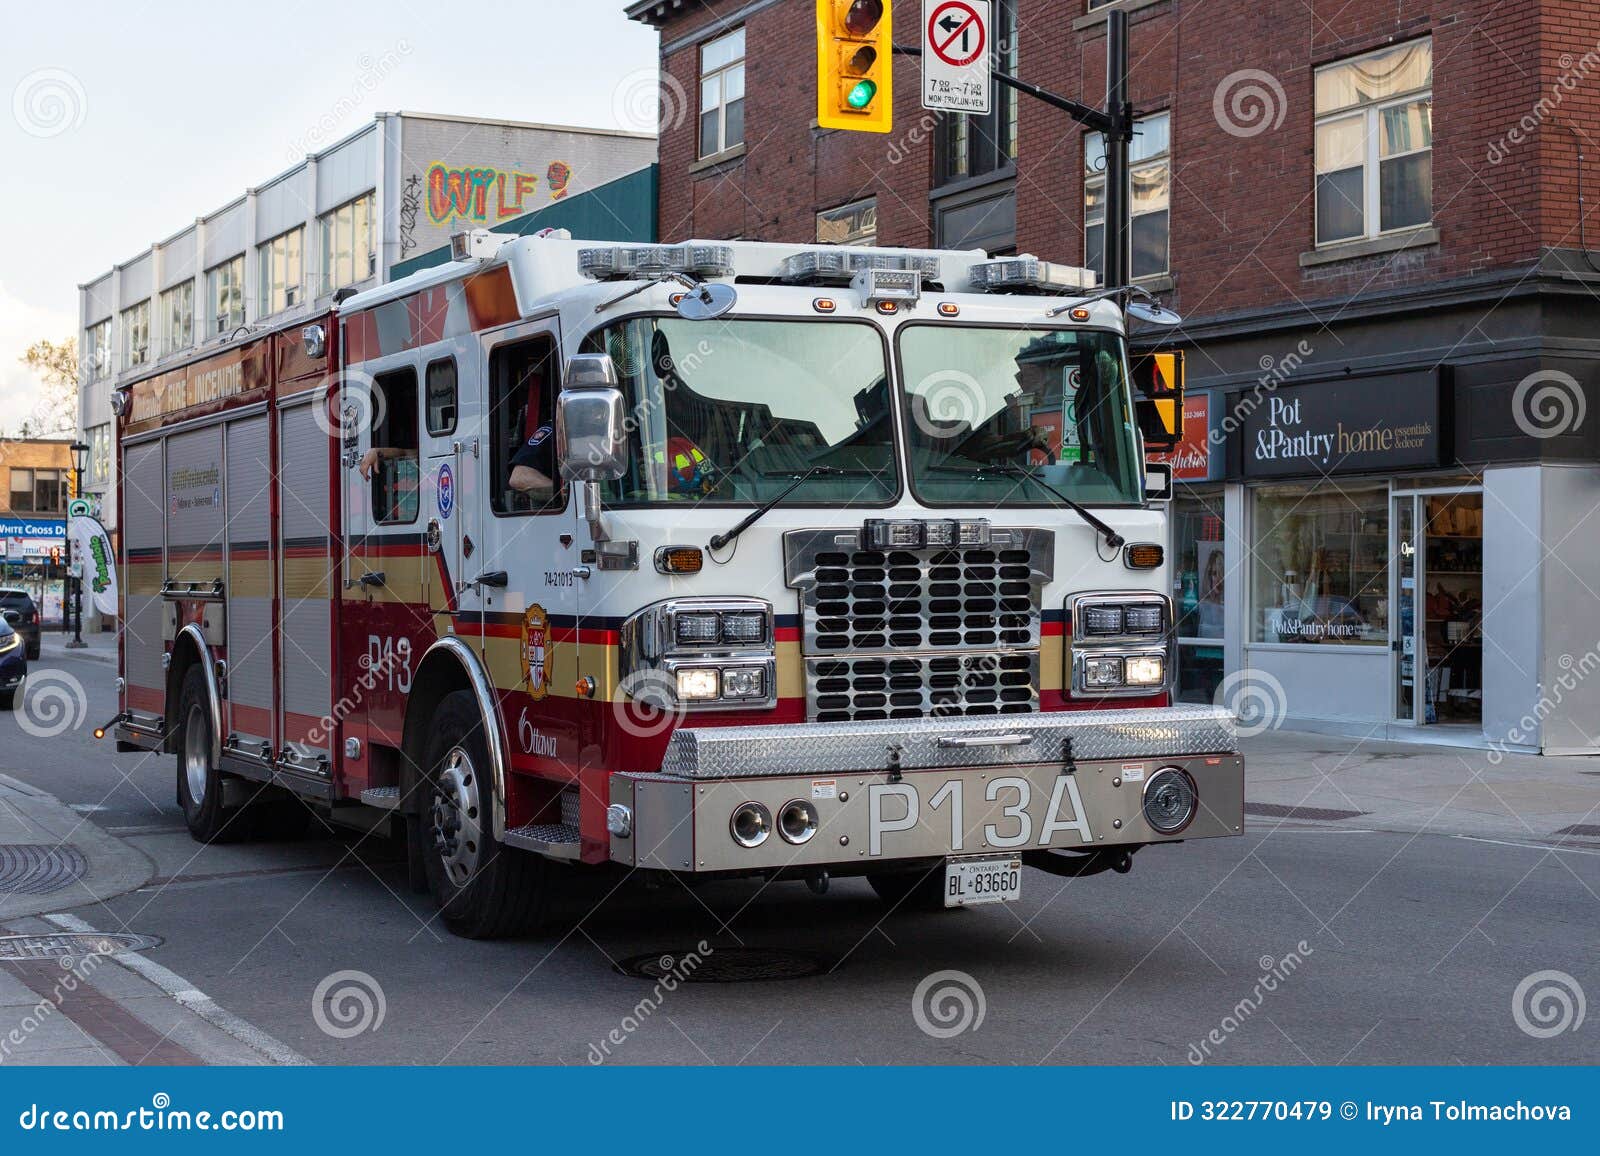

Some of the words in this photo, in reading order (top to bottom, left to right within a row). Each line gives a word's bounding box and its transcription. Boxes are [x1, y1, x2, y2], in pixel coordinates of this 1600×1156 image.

[931, 80, 937, 91] 7
[168, 380, 186, 412] FIRE
[195, 362, 241, 403] INCENDIE
[1269, 397, 1301, 426] Pot
[1255, 429, 1335, 464] &Pantry
[1338, 422, 1393, 453] home
[1394, 422, 1431, 437] essentials
[544, 572, 573, 587] 74-21013
[1327, 620, 1355, 636] home
[368, 634, 412, 694] P13
[518, 706, 557, 758] Ottawa
[868, 774, 1094, 856] P13A
[949, 875, 965, 896] BL
[975, 871, 1018, 893] 83660
